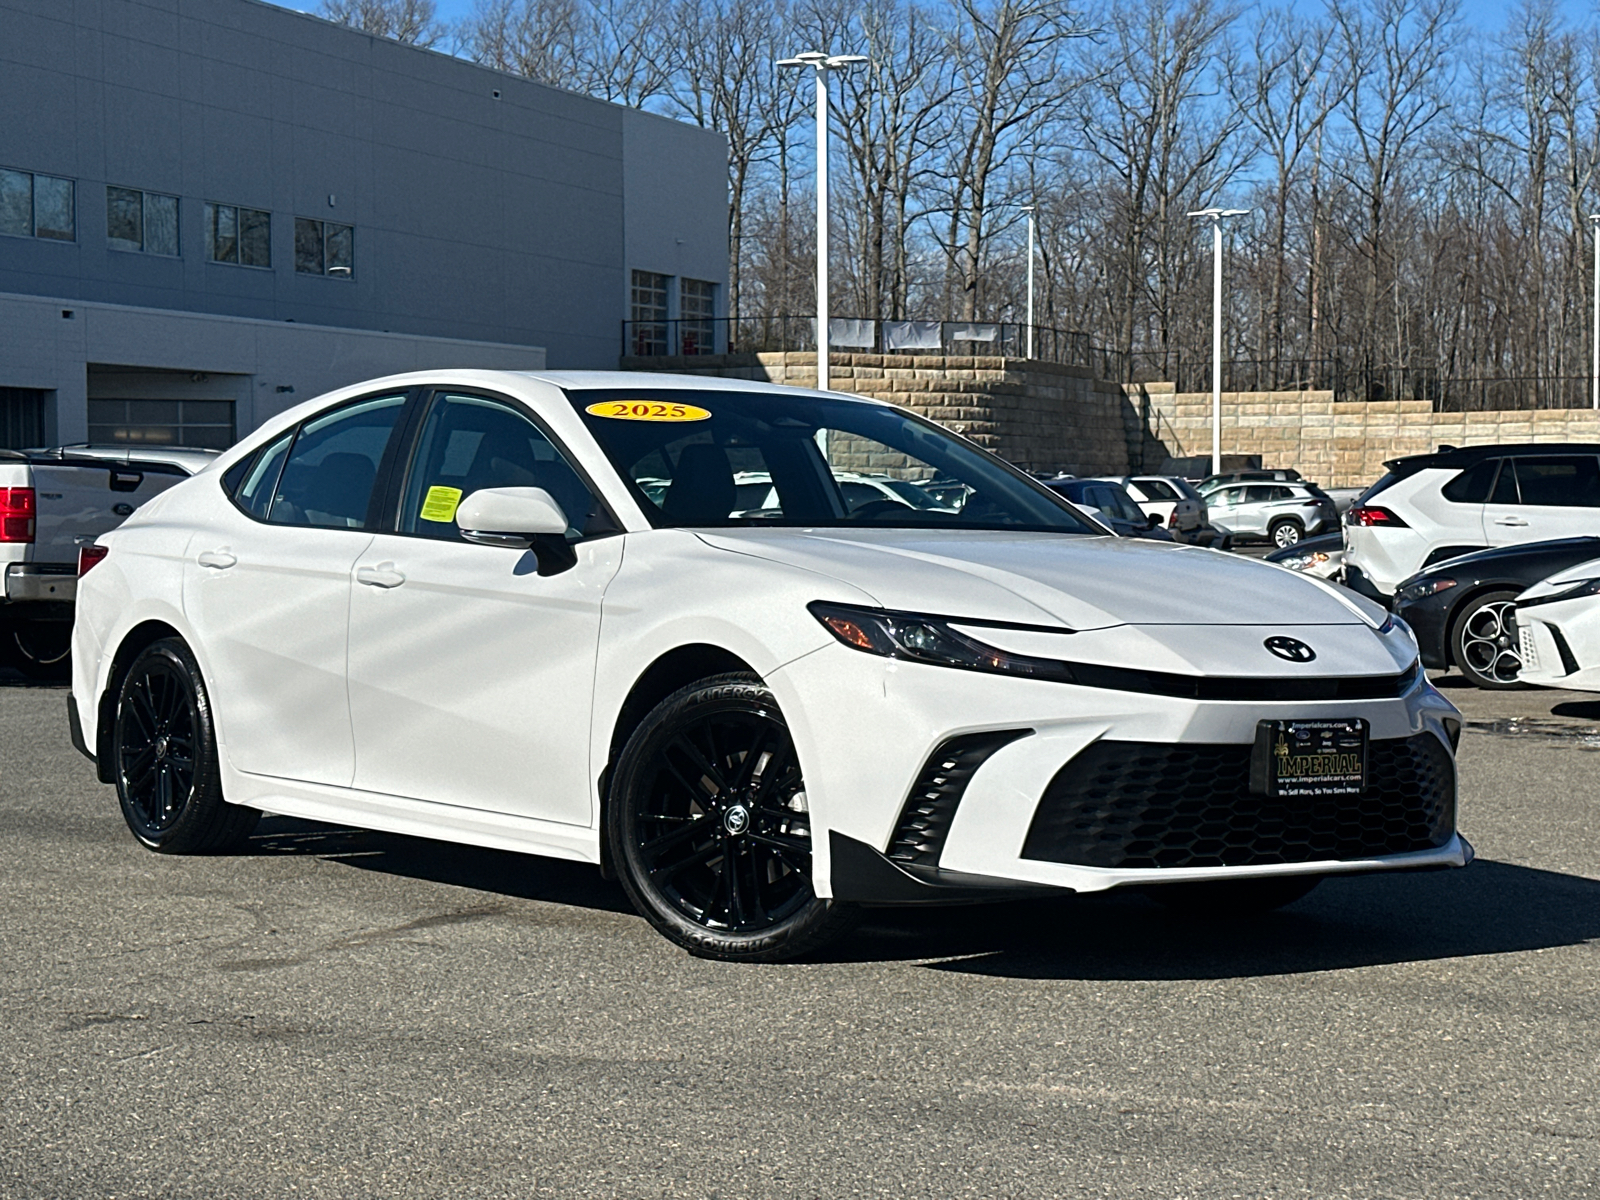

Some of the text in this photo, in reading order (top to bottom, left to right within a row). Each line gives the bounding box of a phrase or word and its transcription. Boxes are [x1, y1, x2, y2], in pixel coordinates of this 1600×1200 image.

[612, 404, 686, 417] 2025
[1277, 754, 1361, 776] IMPERIAL
[1277, 775, 1361, 783] www.imperialcars.com
